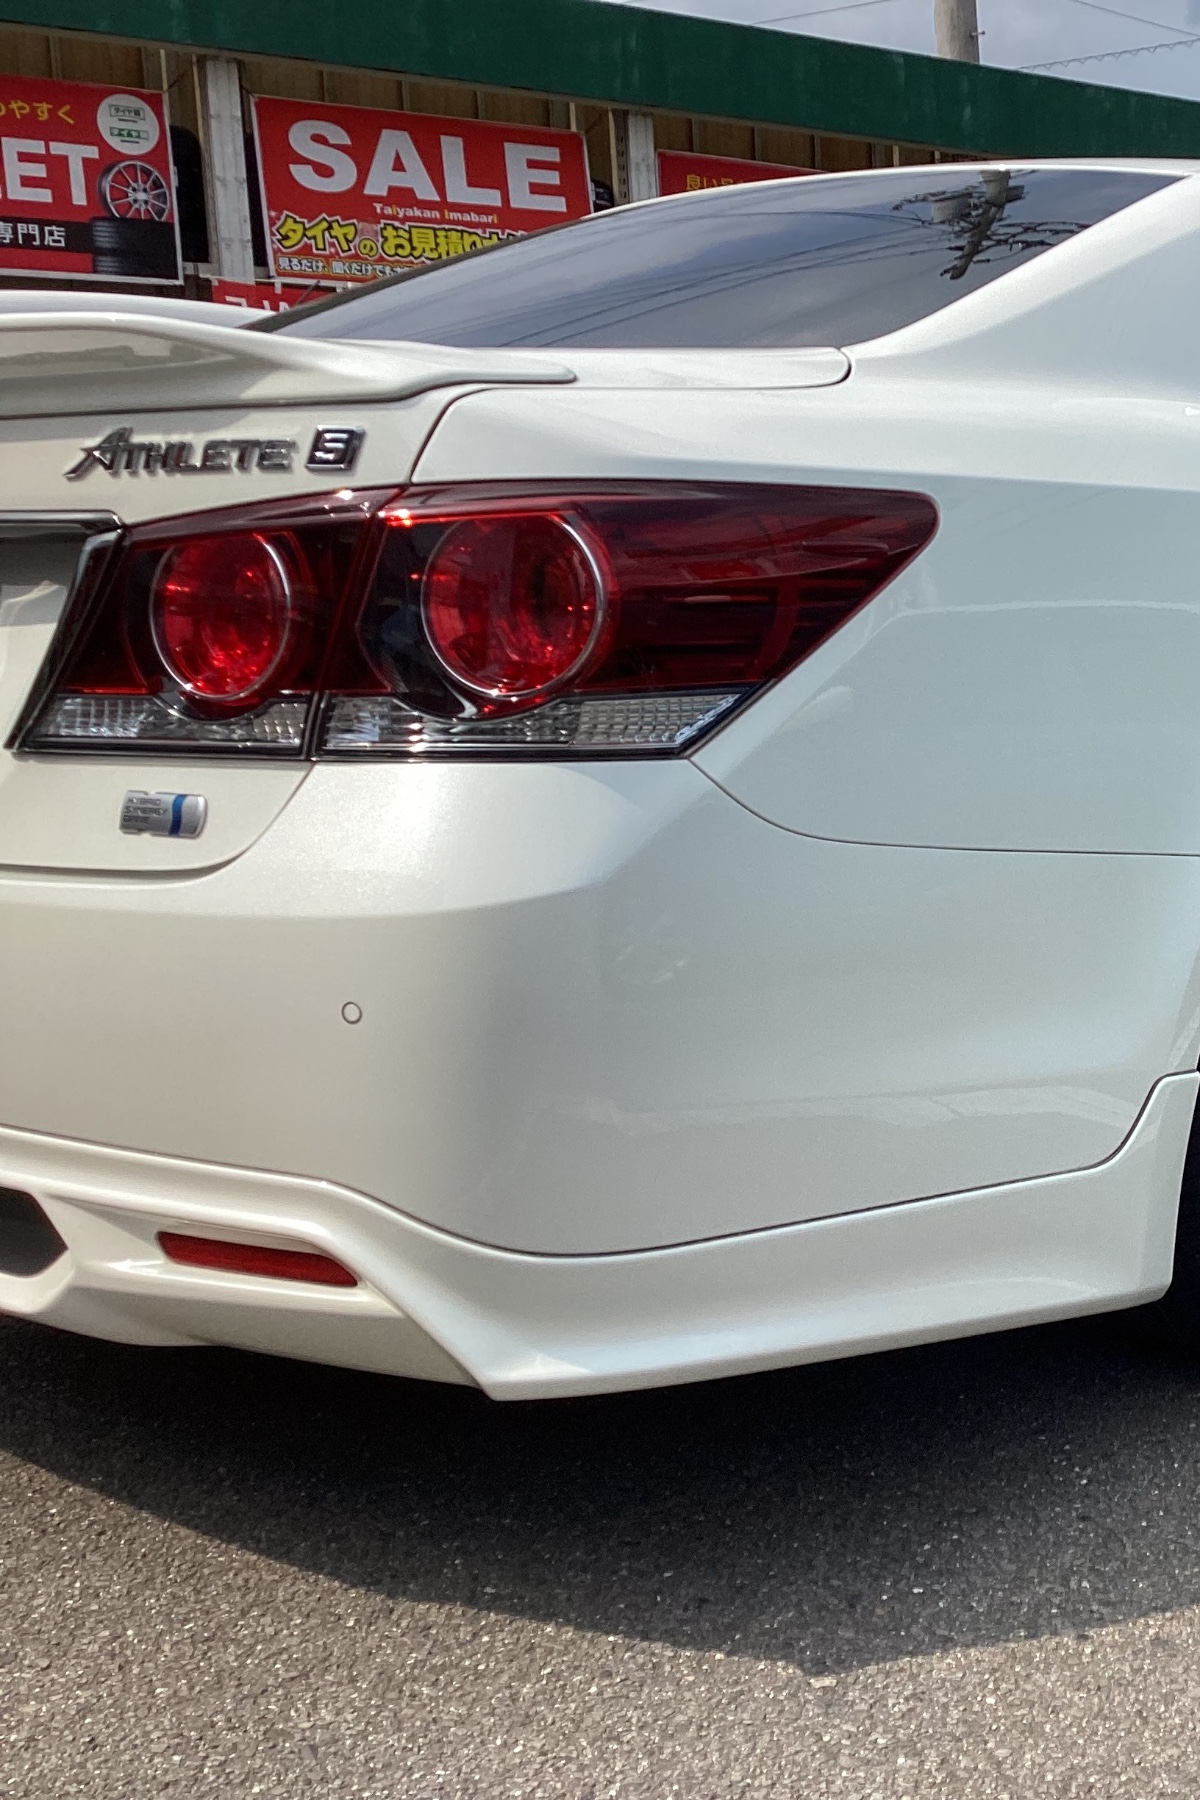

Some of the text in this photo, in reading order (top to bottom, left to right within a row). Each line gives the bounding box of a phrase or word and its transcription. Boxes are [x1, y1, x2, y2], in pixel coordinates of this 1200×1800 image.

[287, 119, 566, 213] SALE
[0, 221, 66, 247] 専門店
[373, 203, 498, 224] Taiyakan Imabari
[63, 424, 364, 480] ATHLETE S
